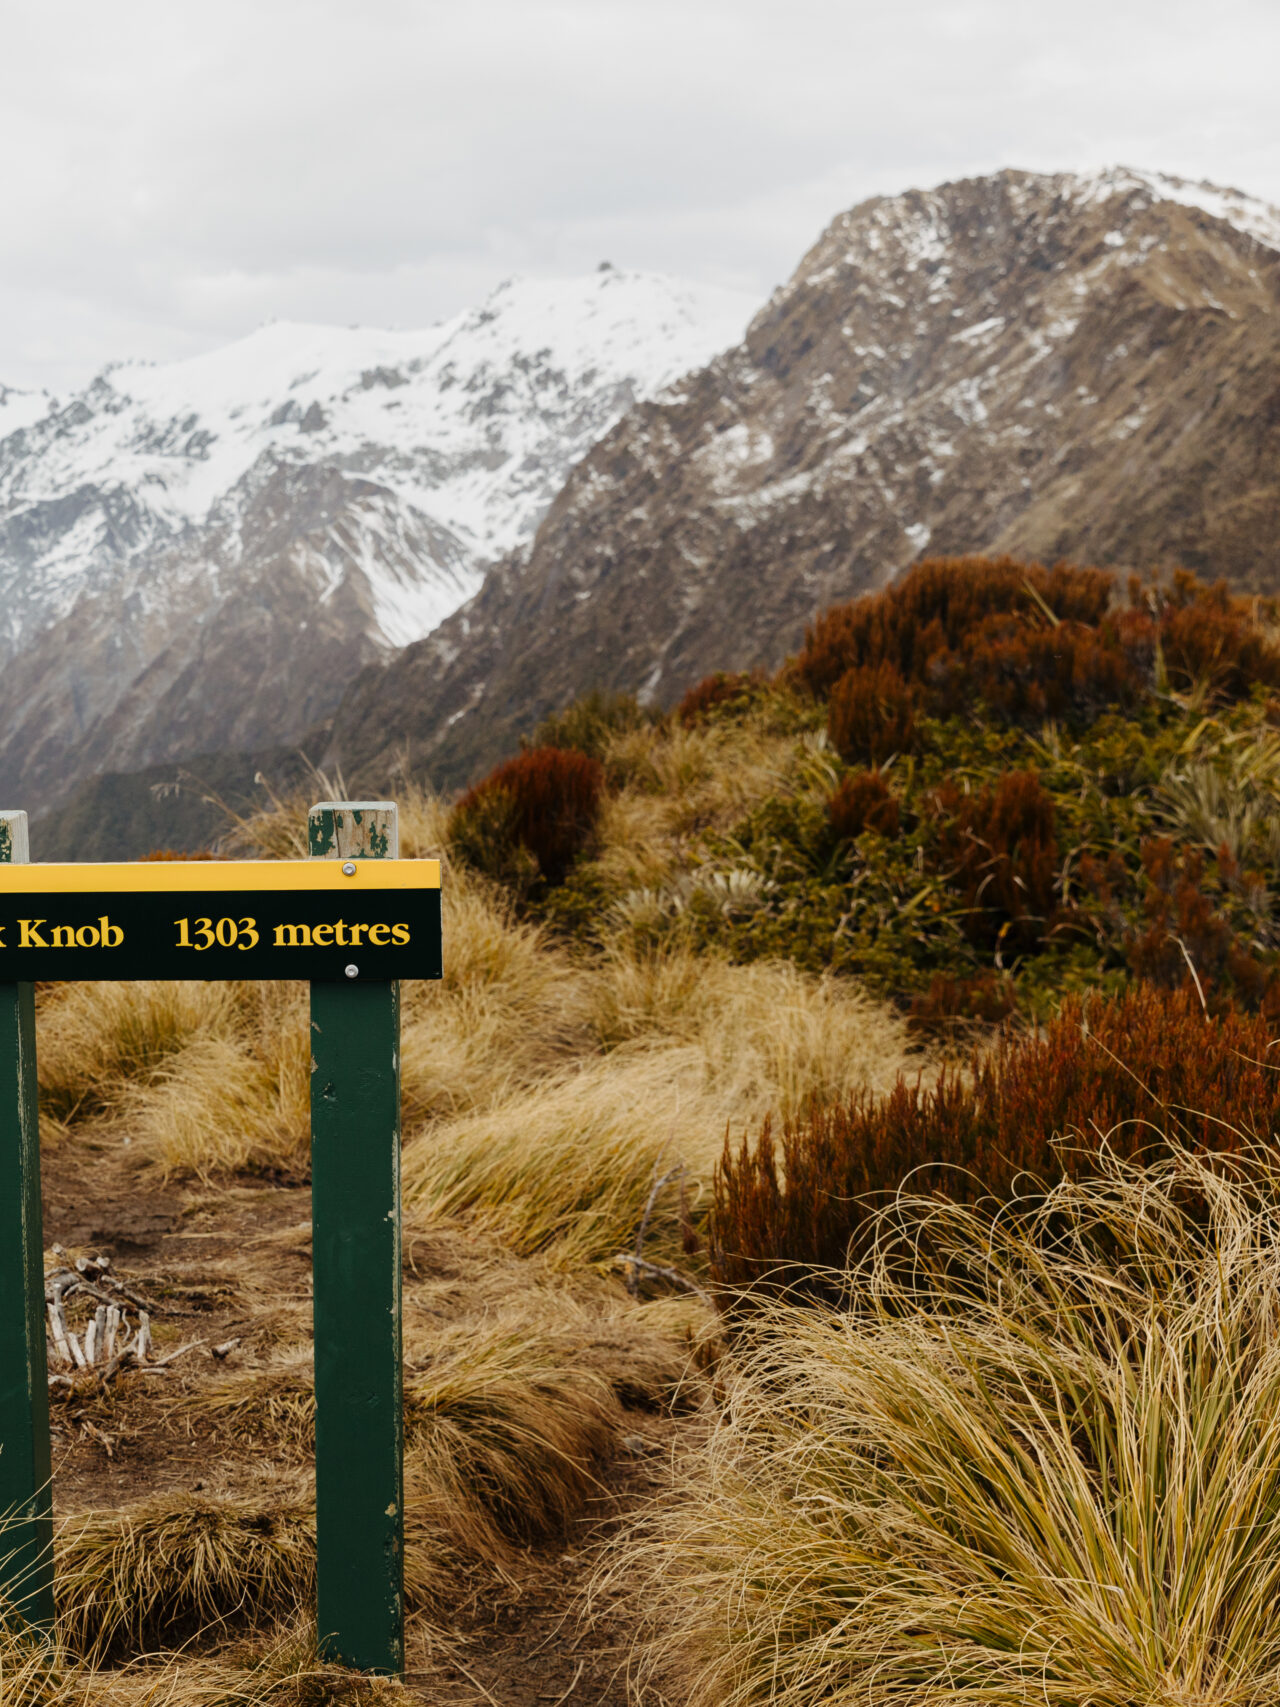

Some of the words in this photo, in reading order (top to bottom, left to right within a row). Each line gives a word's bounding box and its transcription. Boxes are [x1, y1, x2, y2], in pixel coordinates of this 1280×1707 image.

[16, 915, 125, 948] Knob
[173, 917, 260, 951] 1303
[272, 918, 411, 947] metres
